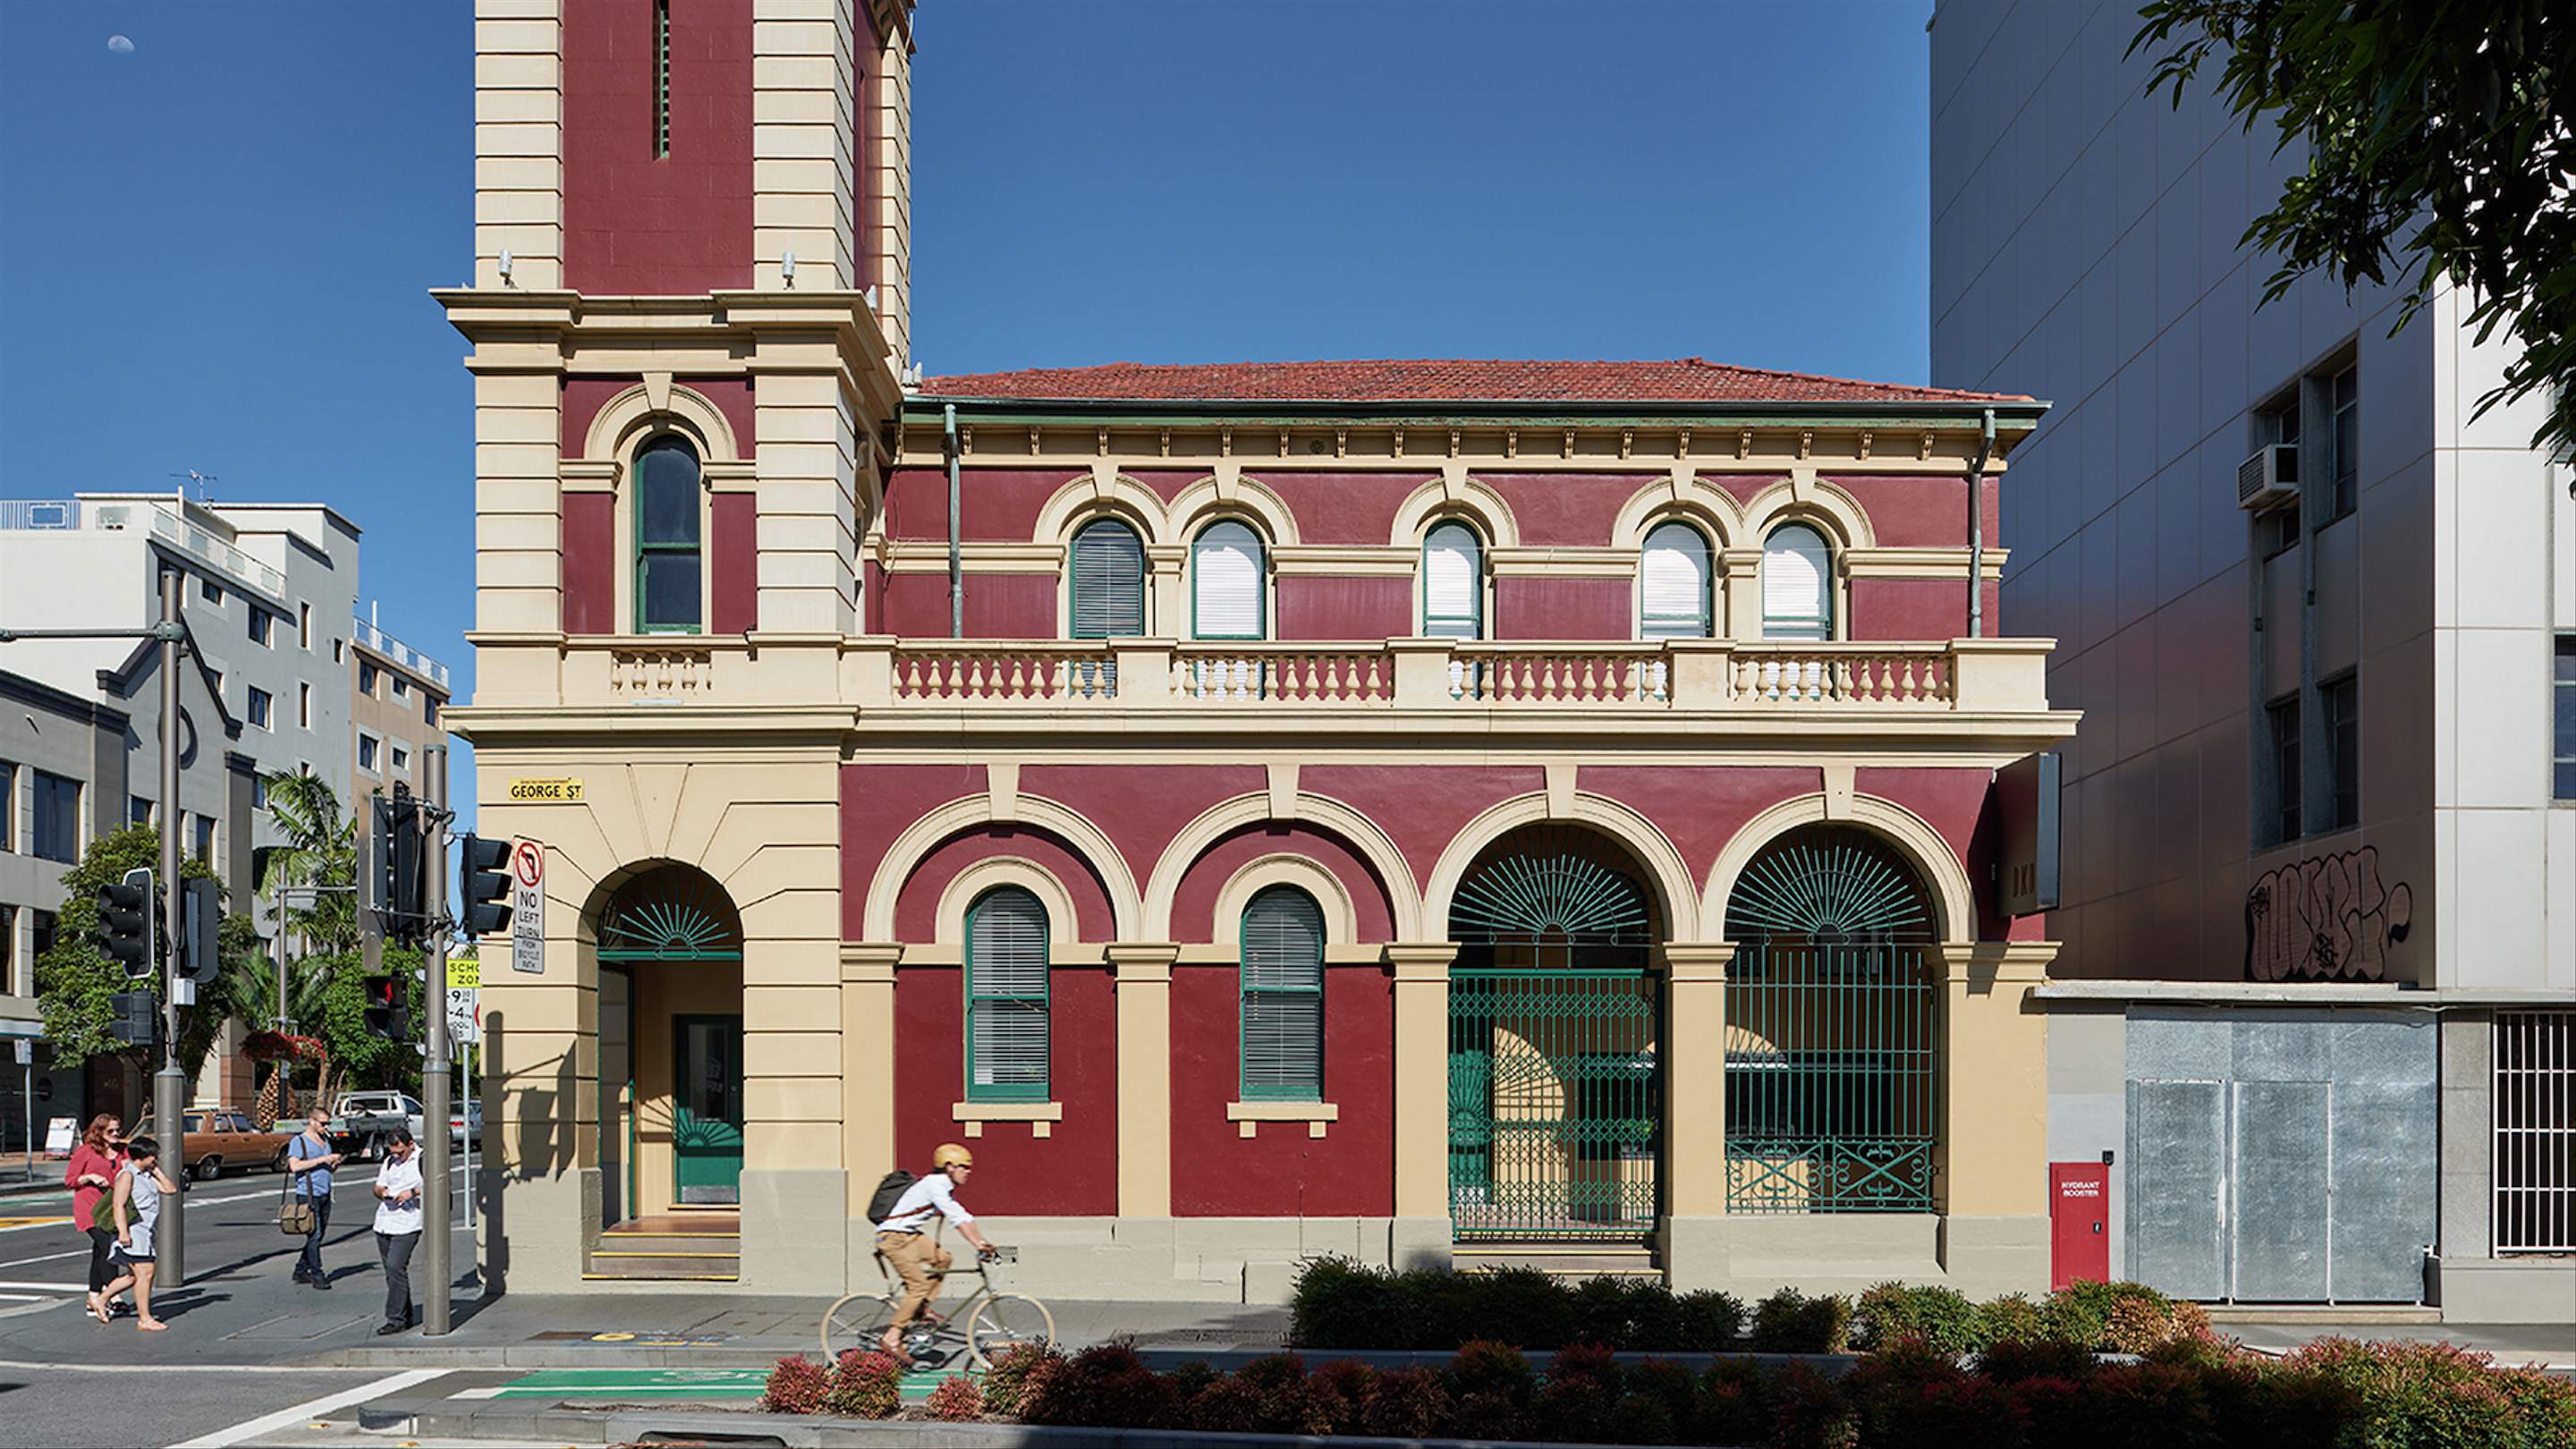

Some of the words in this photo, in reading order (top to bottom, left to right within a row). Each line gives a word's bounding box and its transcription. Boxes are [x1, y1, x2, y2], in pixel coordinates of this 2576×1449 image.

[511, 785, 561, 798] GEORGE
[520, 891, 538, 909] NO
[519, 911, 539, 925] LEFT
[2061, 1181, 2100, 1189] HYDRANT
[2063, 1189, 2099, 1197] BOOSTER
